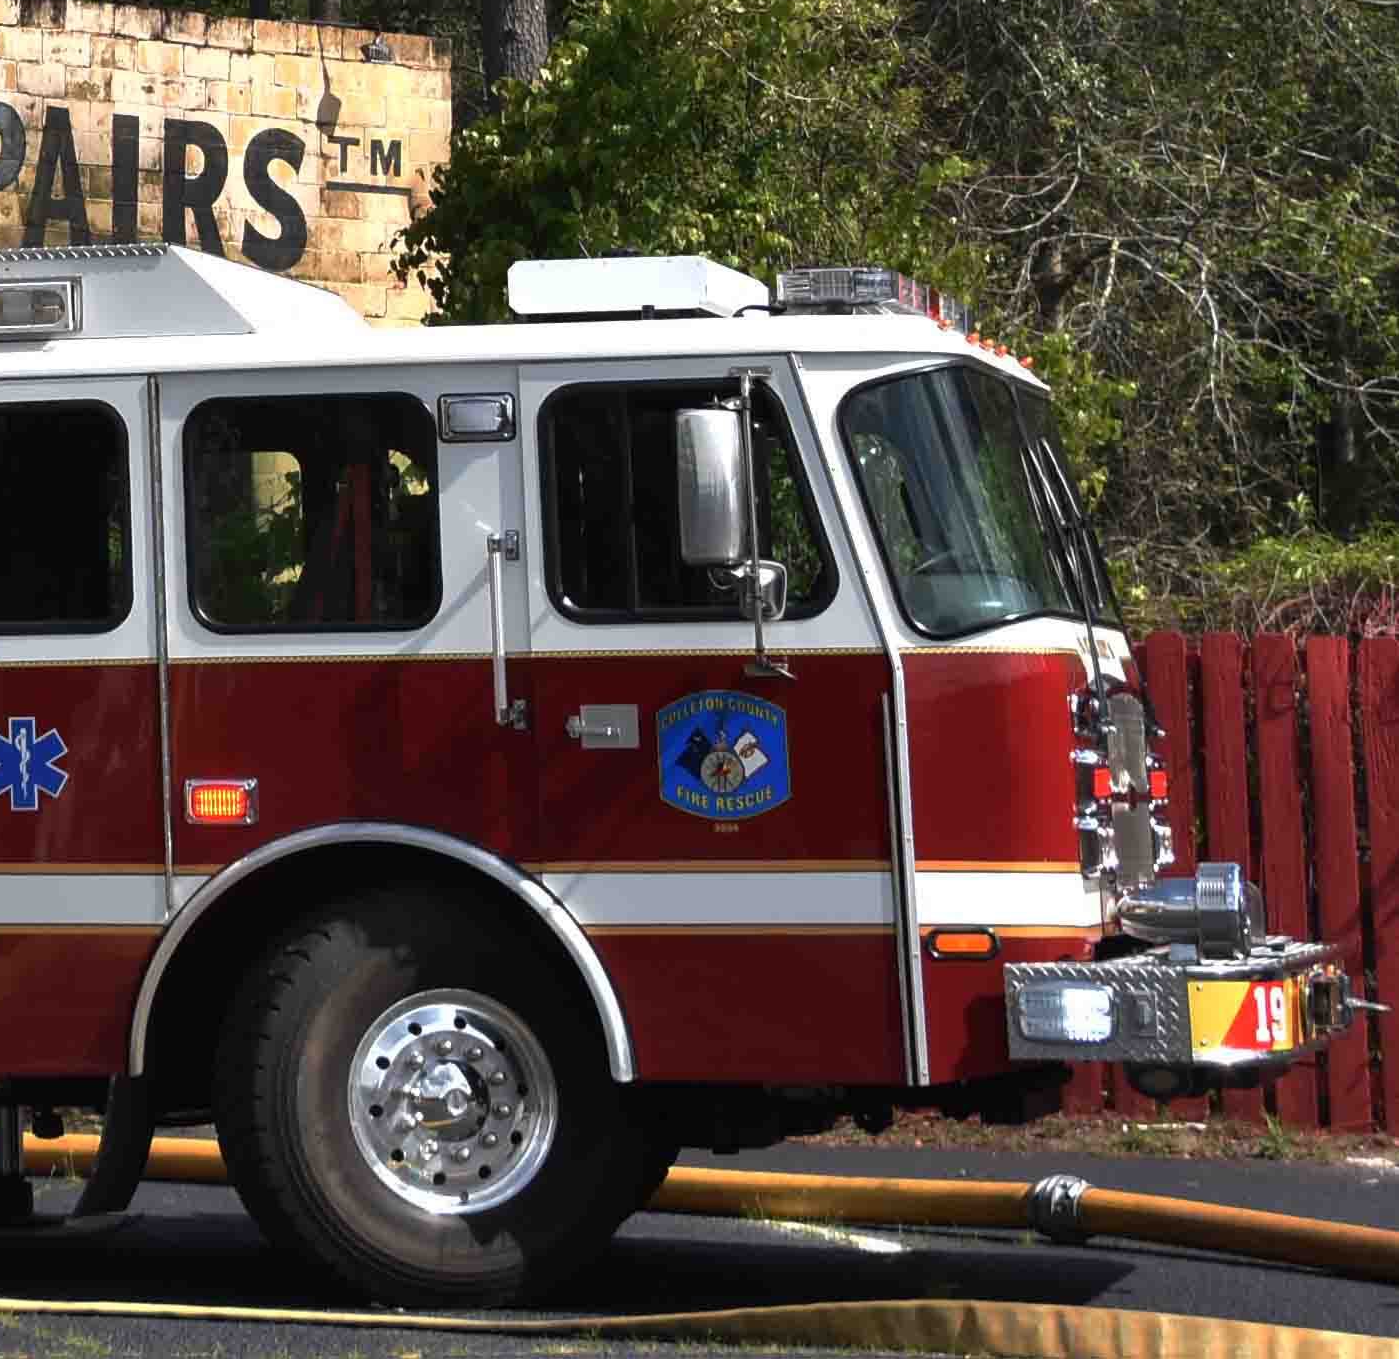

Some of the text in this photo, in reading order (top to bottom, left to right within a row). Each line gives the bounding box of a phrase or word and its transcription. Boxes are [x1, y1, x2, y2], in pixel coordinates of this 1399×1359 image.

[327, 136, 402, 177] TM
[676, 784, 773, 813] FIRE RESCUE
[1254, 986, 1286, 1043] 19
